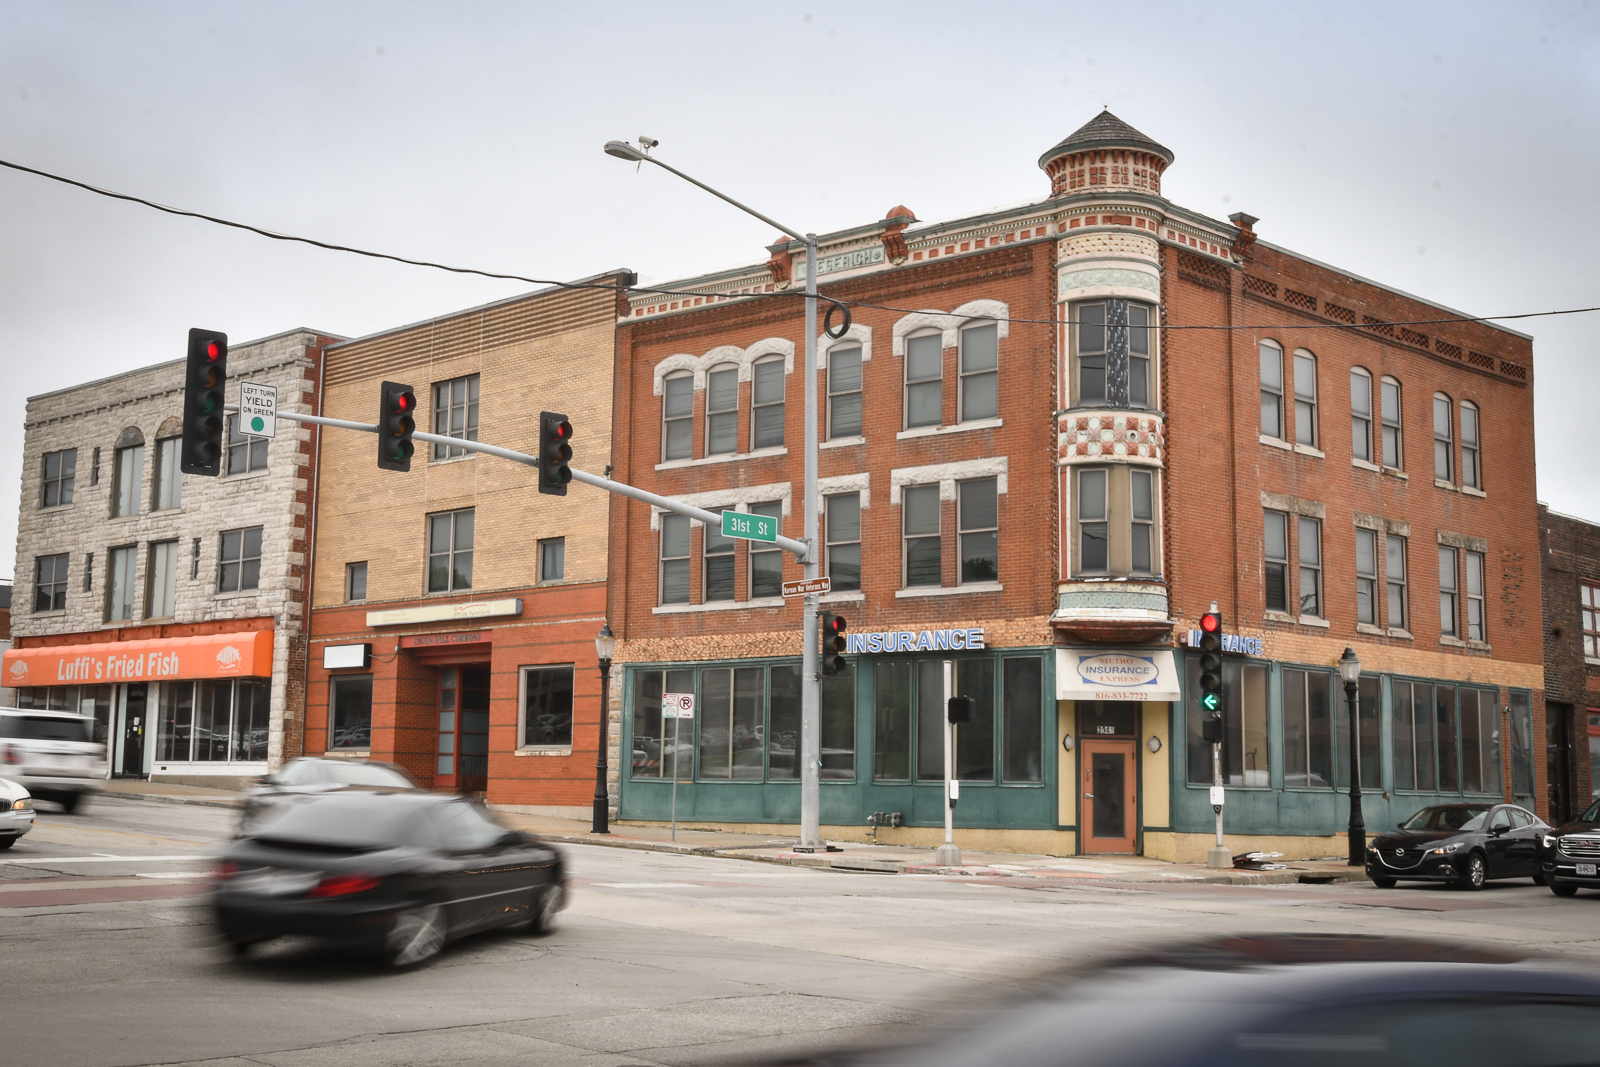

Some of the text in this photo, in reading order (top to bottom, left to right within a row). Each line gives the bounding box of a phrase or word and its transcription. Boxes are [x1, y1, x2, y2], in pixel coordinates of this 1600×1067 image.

[816, 250, 871, 275] ESERICH
[246, 396, 272, 407] YIELD
[254, 408, 273, 416] GREEN
[731, 518, 768, 535] 31st St
[821, 582, 829, 590] Way
[414, 633, 481, 645] UNION HILL COMMONS
[846, 628, 985, 653] INSURANCE
[1190, 629, 1262, 655] INRANCE
[58, 651, 179, 681] Luffi's Fried Fish
[1086, 666, 1150, 674] INSURANCE
[1095, 692, 1148, 700] 816-833-7722
